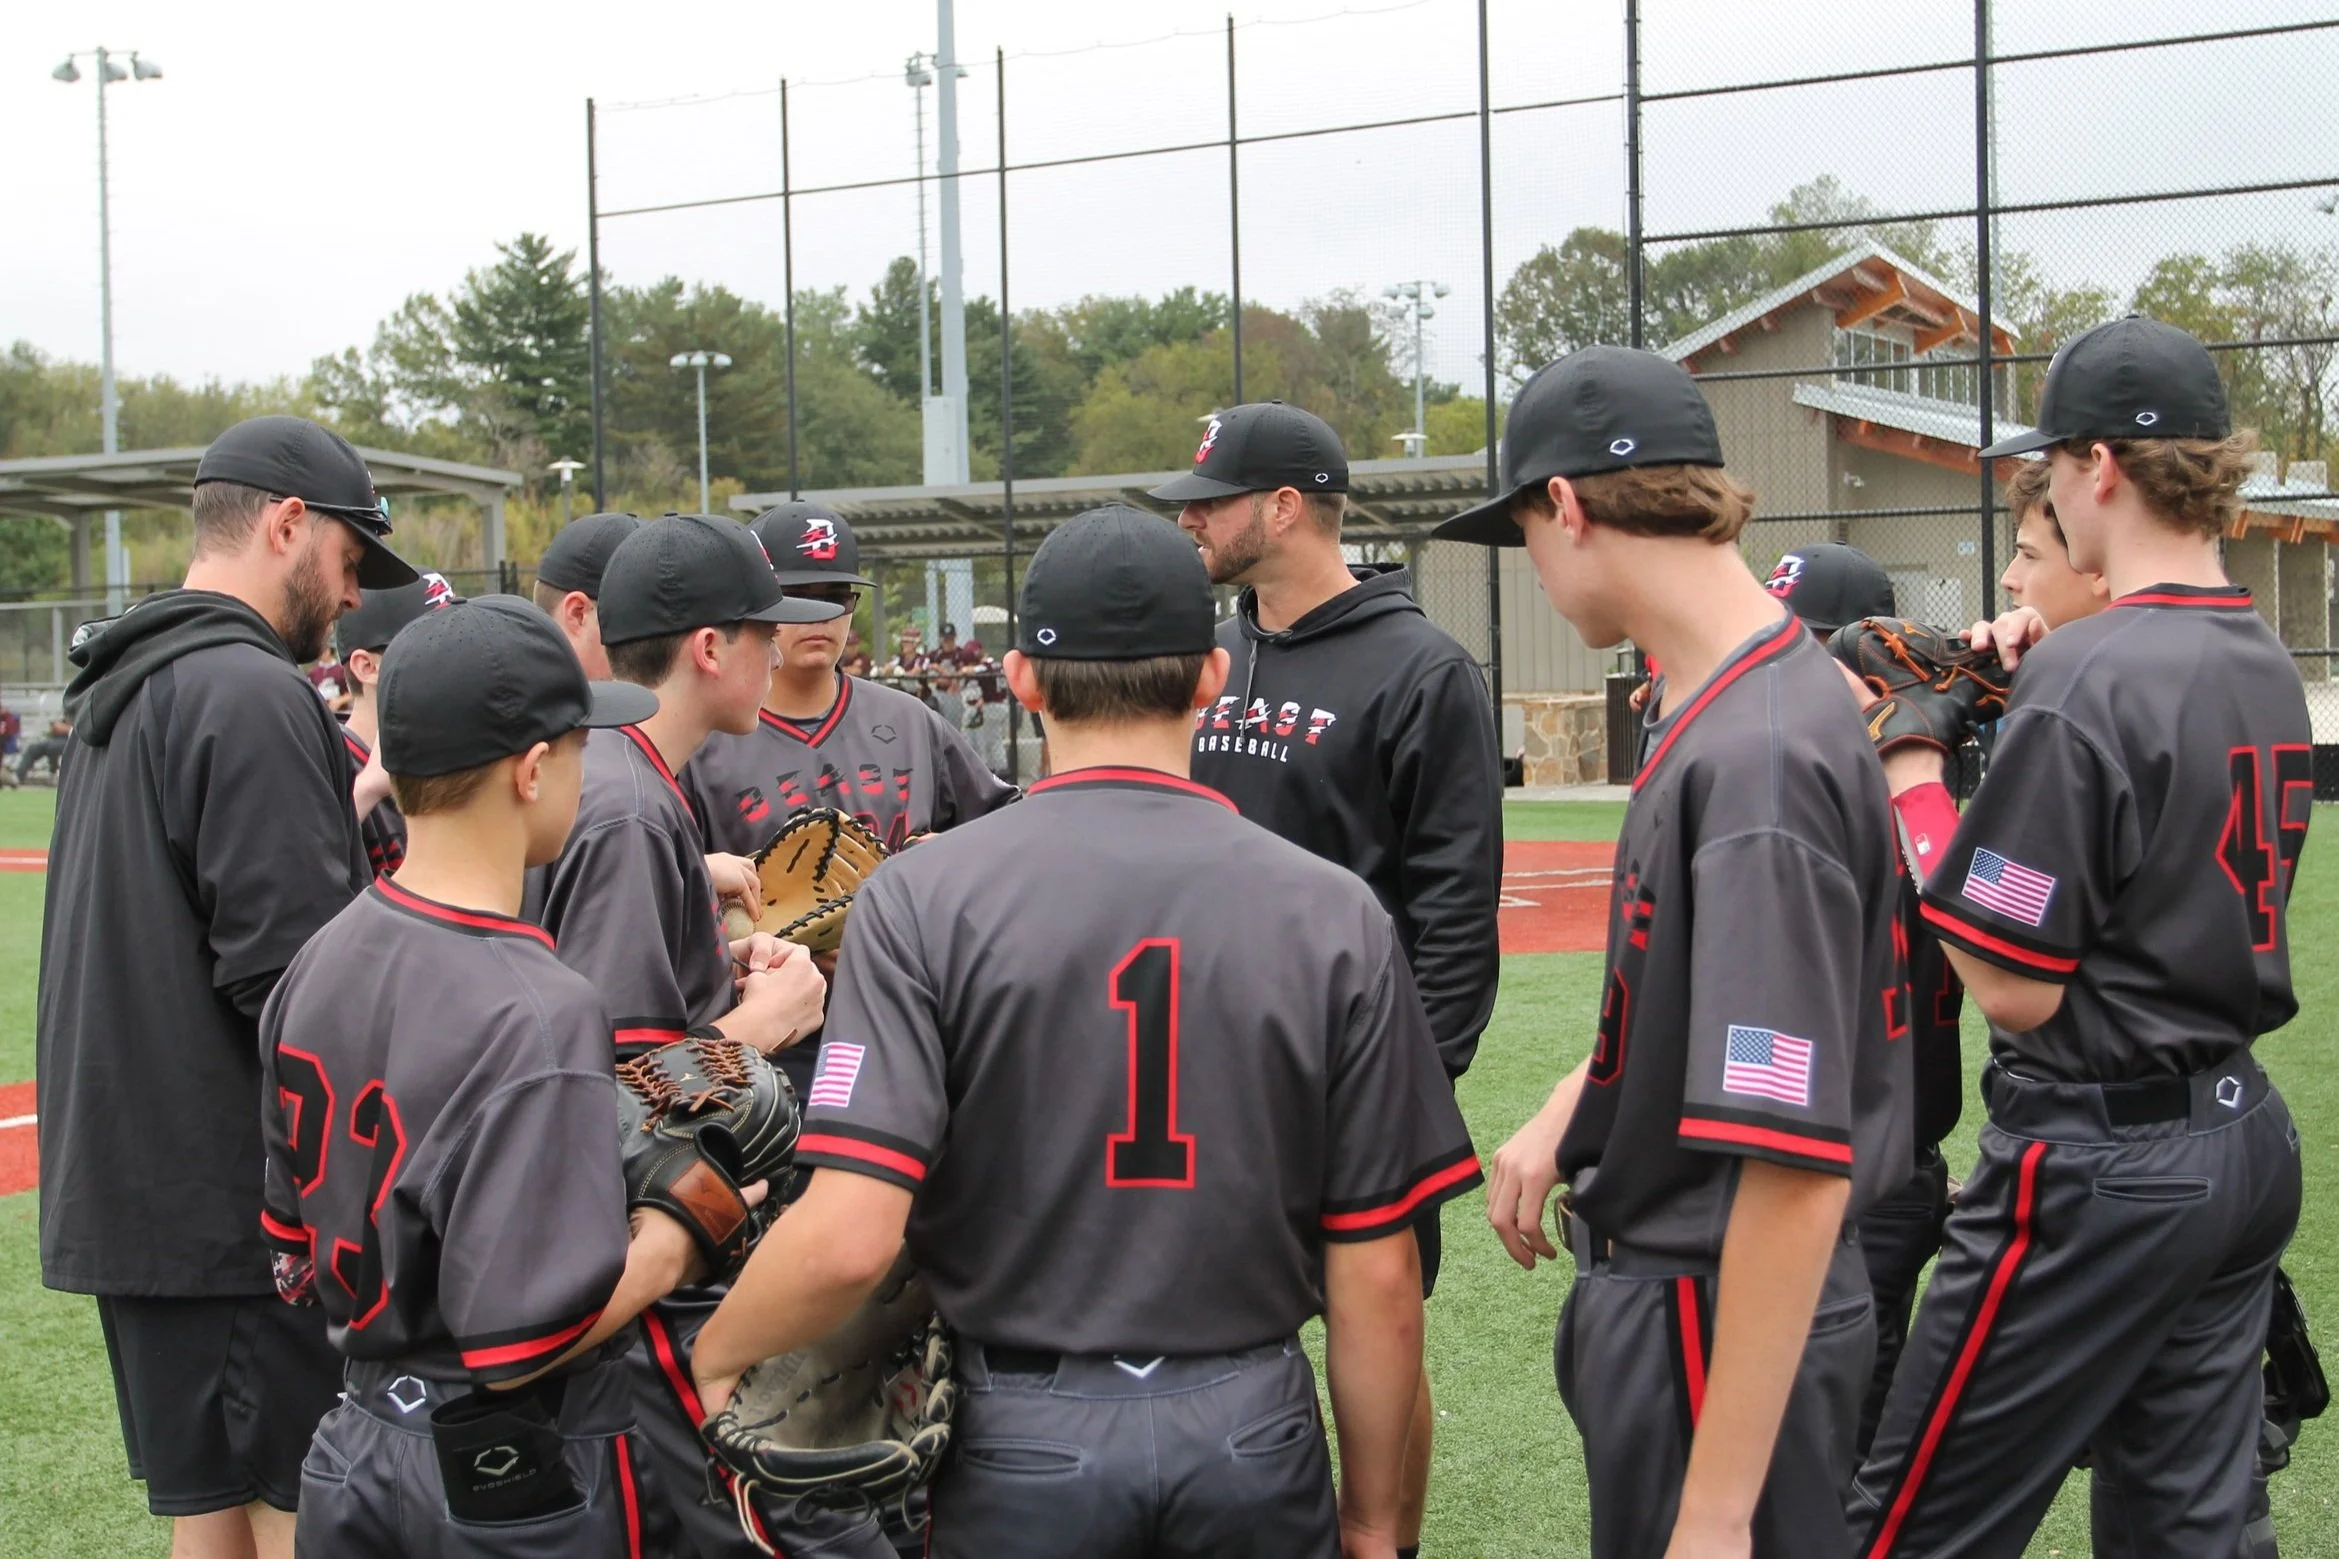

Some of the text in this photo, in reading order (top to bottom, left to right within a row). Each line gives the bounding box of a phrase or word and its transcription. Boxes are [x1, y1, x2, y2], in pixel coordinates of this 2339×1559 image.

[1198, 735, 1289, 763] BASEBALL
[734, 762, 914, 823] BEAST
[1105, 936, 1197, 1188] 1
